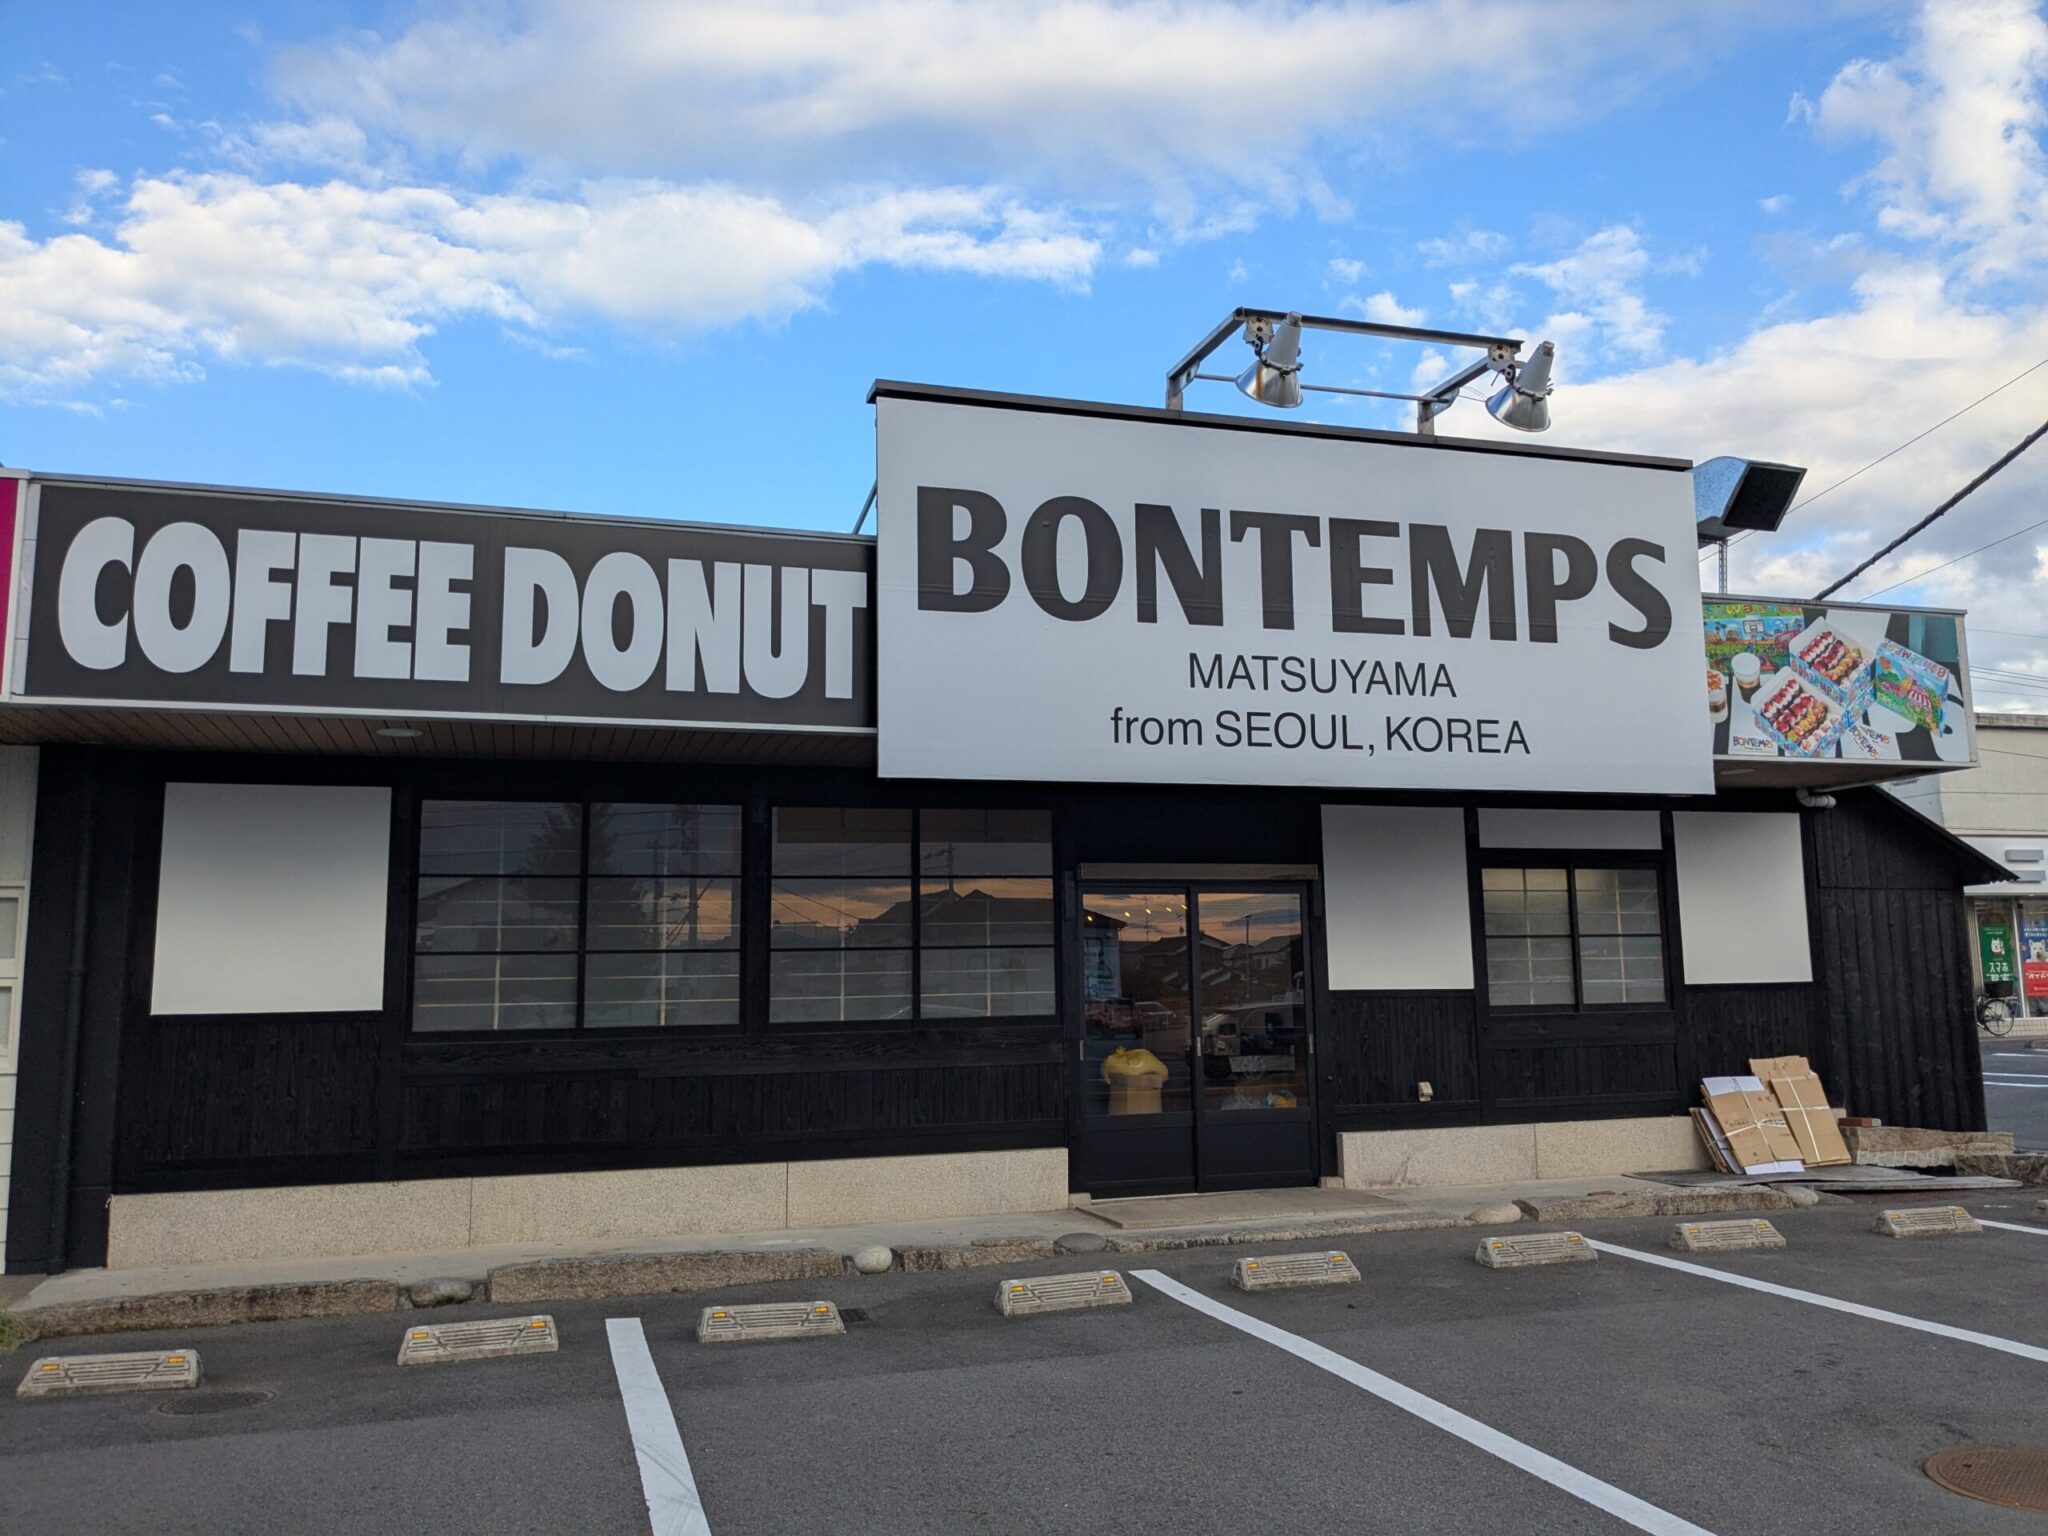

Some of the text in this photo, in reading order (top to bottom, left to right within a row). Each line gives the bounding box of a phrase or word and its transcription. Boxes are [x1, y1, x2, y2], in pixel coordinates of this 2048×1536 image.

[916, 486, 1673, 650] BONTEMPS
[57, 516, 868, 700] COFFEE DONUT
[1188, 652, 1458, 698] MATSUYAMA
[1110, 706, 1531, 757] from SEOUL, KOREA
[1732, 735, 1774, 749] BONTEMPS
